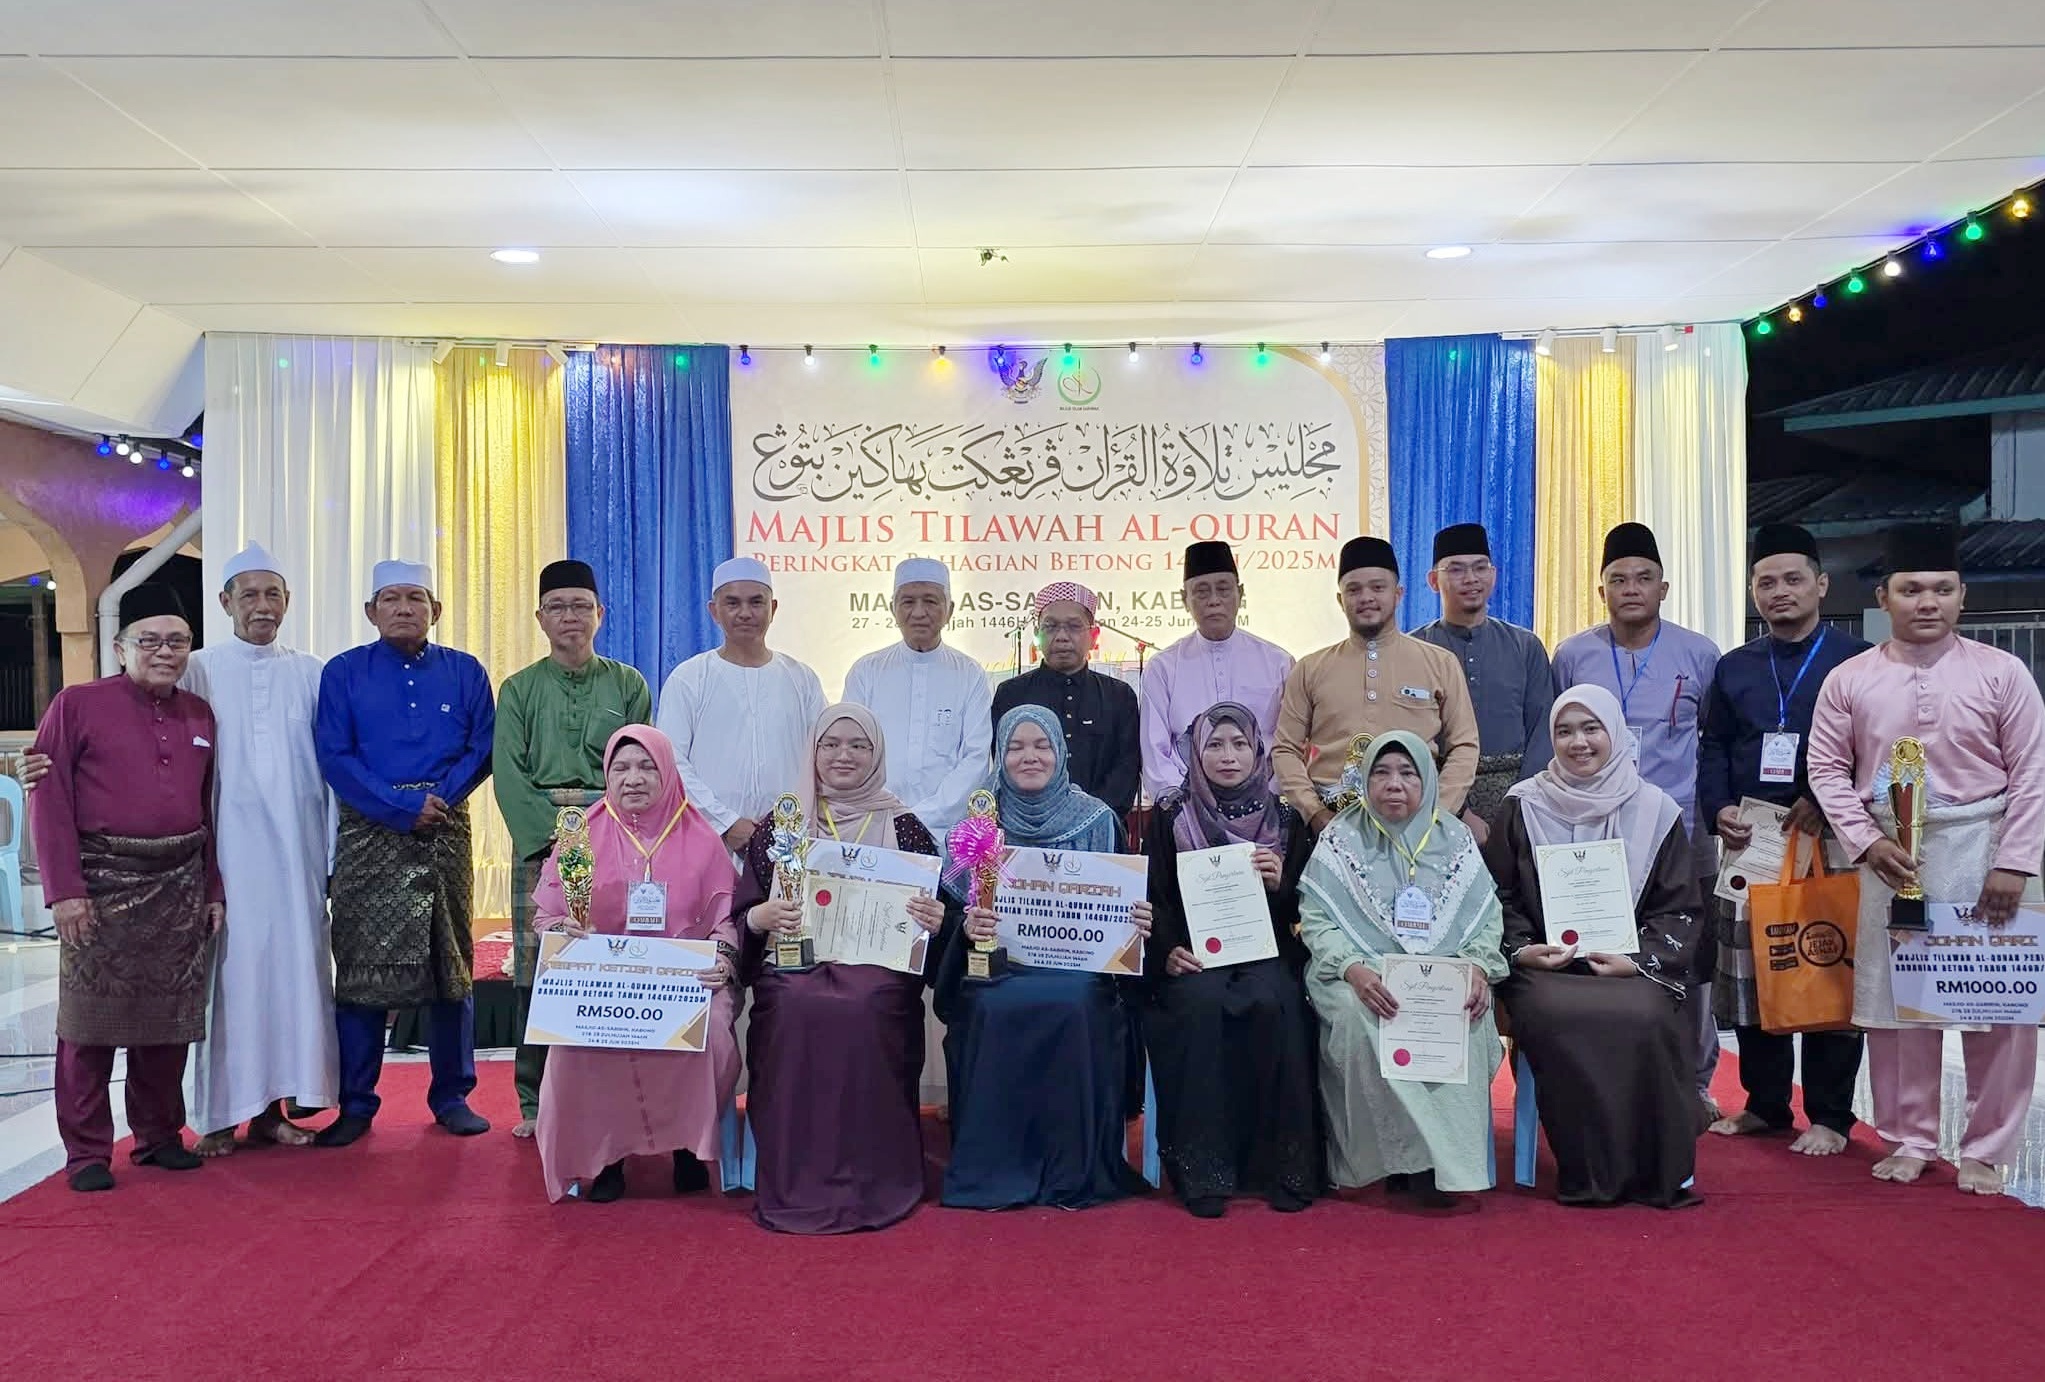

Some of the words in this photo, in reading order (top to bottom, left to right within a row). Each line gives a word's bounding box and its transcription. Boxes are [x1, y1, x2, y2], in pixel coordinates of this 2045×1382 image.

[745, 510, 895, 551] MAJLIS
[911, 510, 1105, 543] TILAWAH
[1119, 512, 1341, 548] AL-QURAN
[907, 552, 1038, 572] HAGIAN
[1050, 551, 1153, 571] BETONG
[852, 617, 869, 629] 27
[1122, 615, 1162, 628] 24-25
[1017, 923, 1104, 943] RM1000.00
[1923, 935, 1984, 947] JOHAN
[1936, 980, 2038, 995] RM1000.00
[576, 1004, 664, 1021] RM500.00
